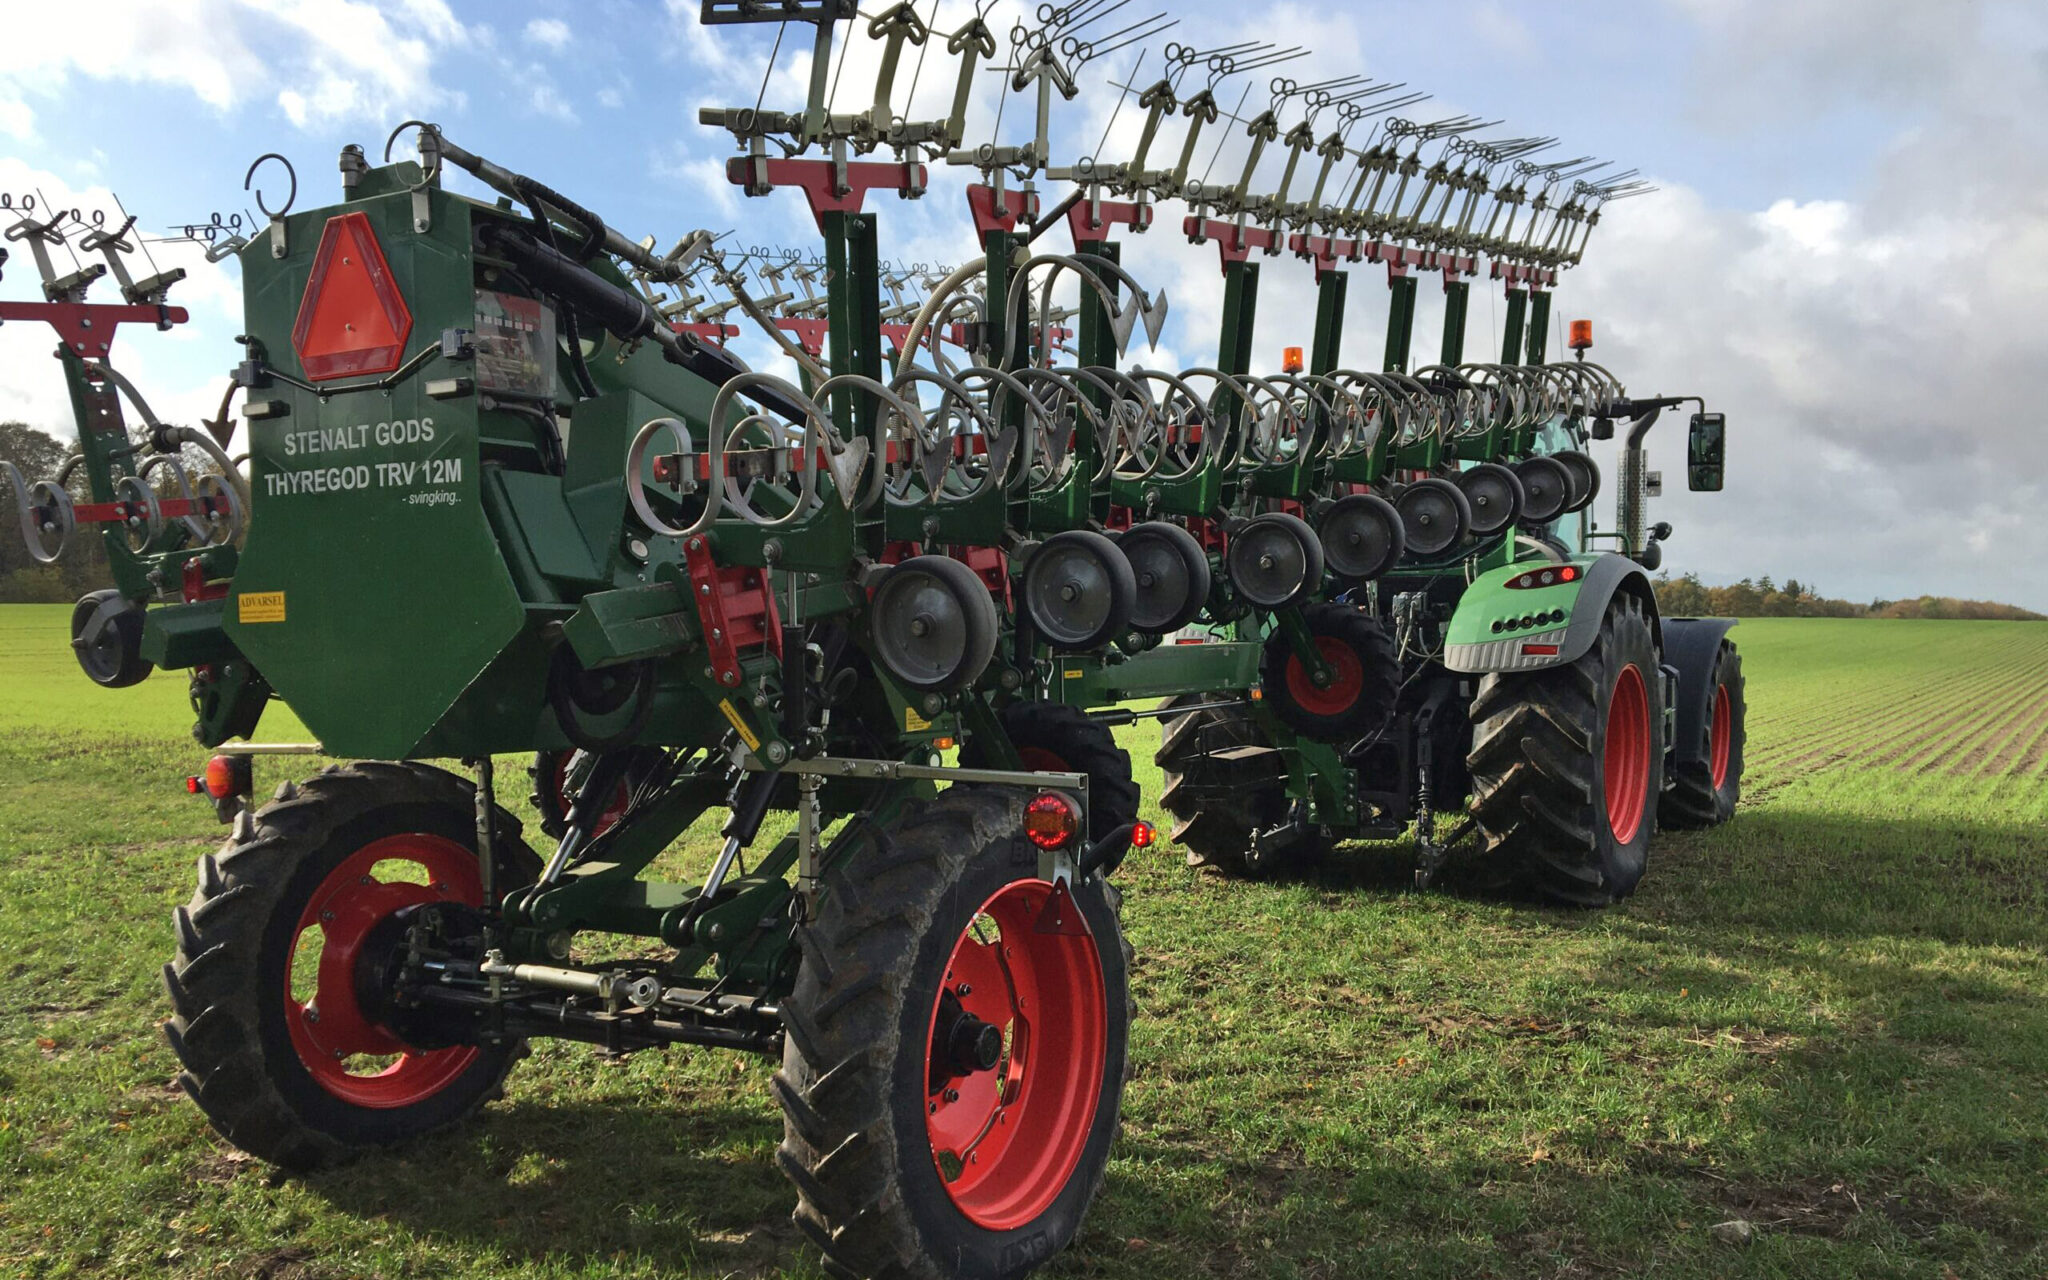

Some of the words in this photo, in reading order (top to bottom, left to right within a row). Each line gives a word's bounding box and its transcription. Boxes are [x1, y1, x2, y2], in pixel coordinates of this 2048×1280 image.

[285, 424, 369, 455] STENALT
[375, 417, 434, 446] GODS
[264, 466, 369, 495] THYREGOD
[375, 461, 415, 487] TRV
[422, 458, 462, 483] 12M
